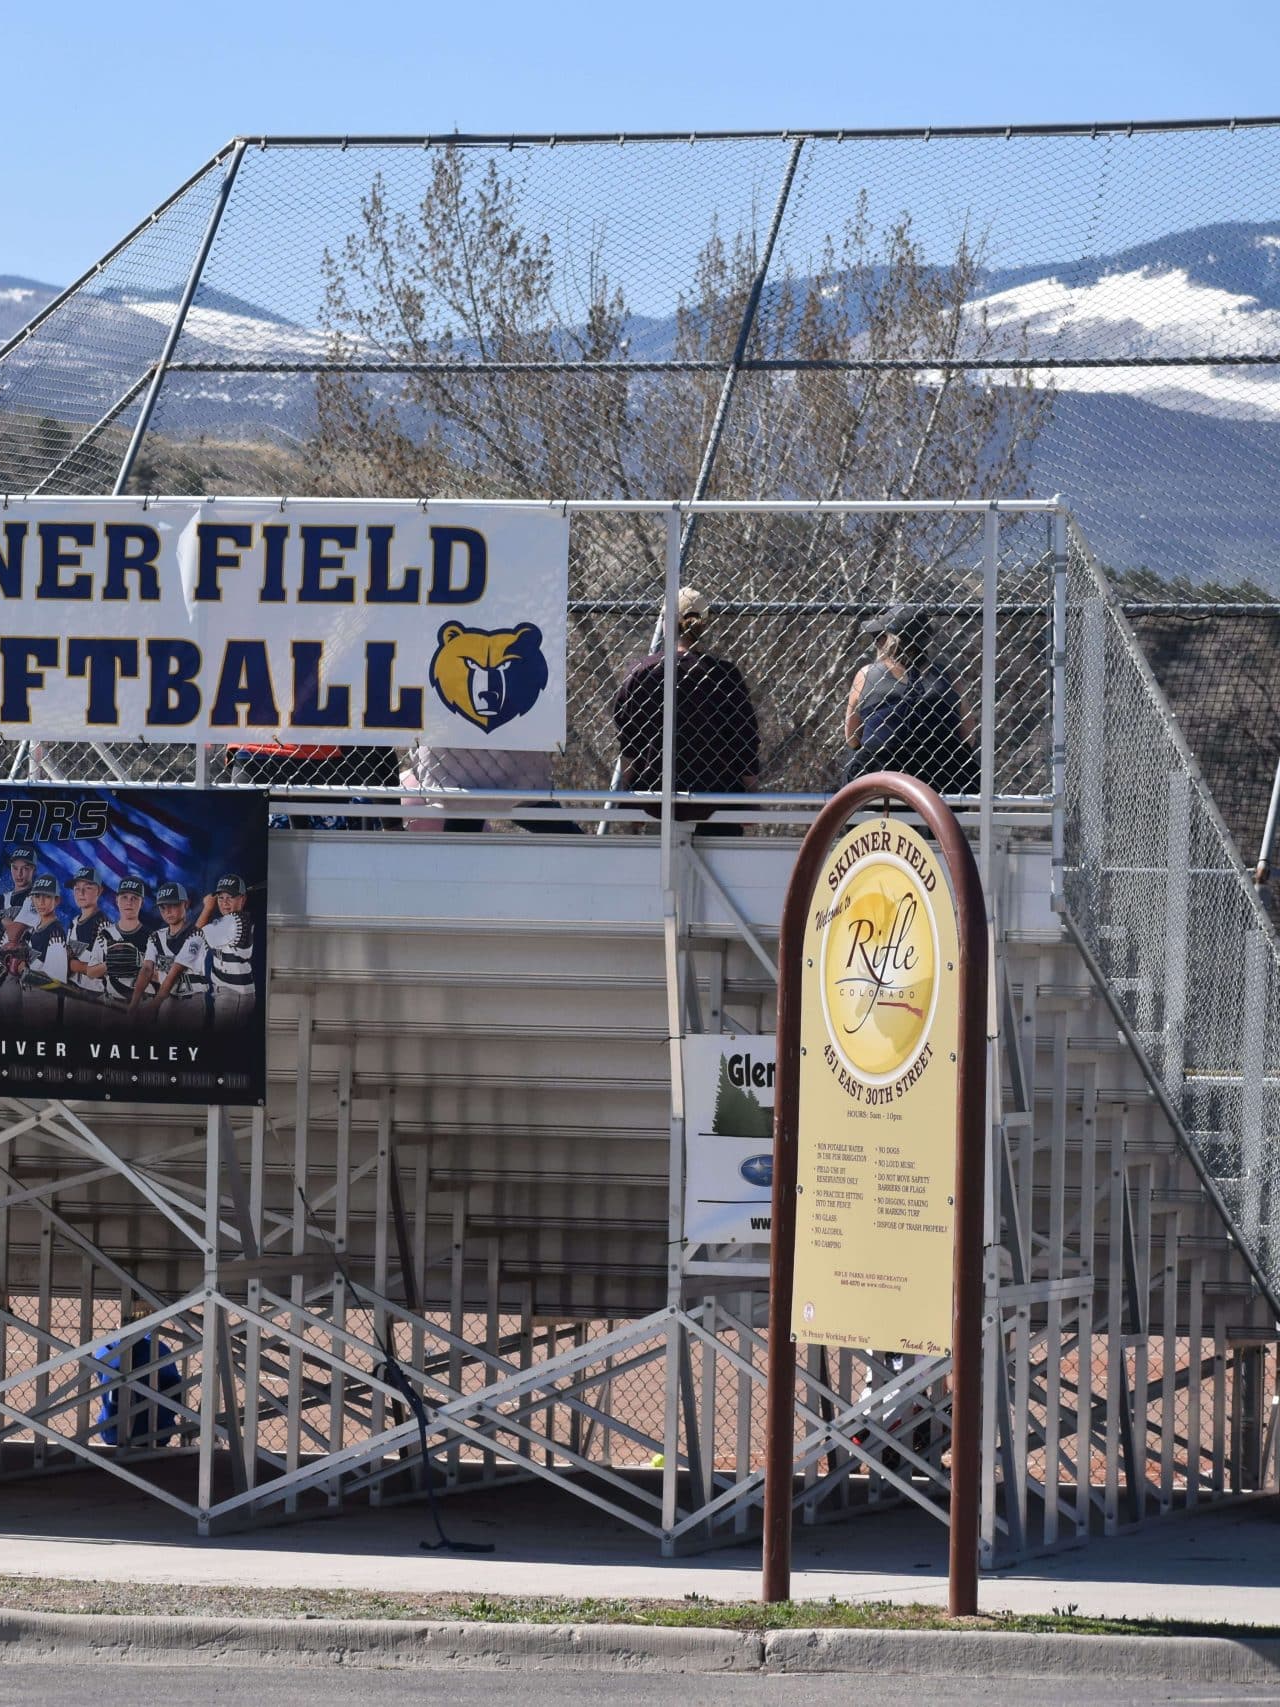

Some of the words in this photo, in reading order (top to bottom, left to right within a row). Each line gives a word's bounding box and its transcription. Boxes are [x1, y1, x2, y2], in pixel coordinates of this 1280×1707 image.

[193, 522, 488, 605] FIELD
[828, 831, 891, 892] SKINNER
[897, 835, 936, 892] FIELD
[120, 881, 139, 889] CRV
[816, 904, 843, 931] Welcome
[843, 892, 919, 1033] Rifle
[840, 988, 915, 999] COLORADO
[90, 1044, 199, 1061] VALLEY
[824, 1044, 839, 1074] 451
[838, 1069, 864, 1101] EAST
[865, 1086, 893, 1105] 30TH
[895, 1042, 933, 1097] STREET
[847, 1110, 868, 1119] HOURS:
[879, 1146, 885, 1154] NO
[886, 1160, 899, 1168] LOUD
[878, 1173, 885, 1181] DO
[896, 1175, 910, 1183] MOVE
[911, 1176, 930, 1184] SAFETY
[897, 1222, 904, 1230] OF
[876, 1273, 908, 1283] RECREATION
[825, 1332, 847, 1342] Working
[848, 1334, 857, 1342] For
[900, 1338, 923, 1350] Thank
[926, 1341, 941, 1353] You
